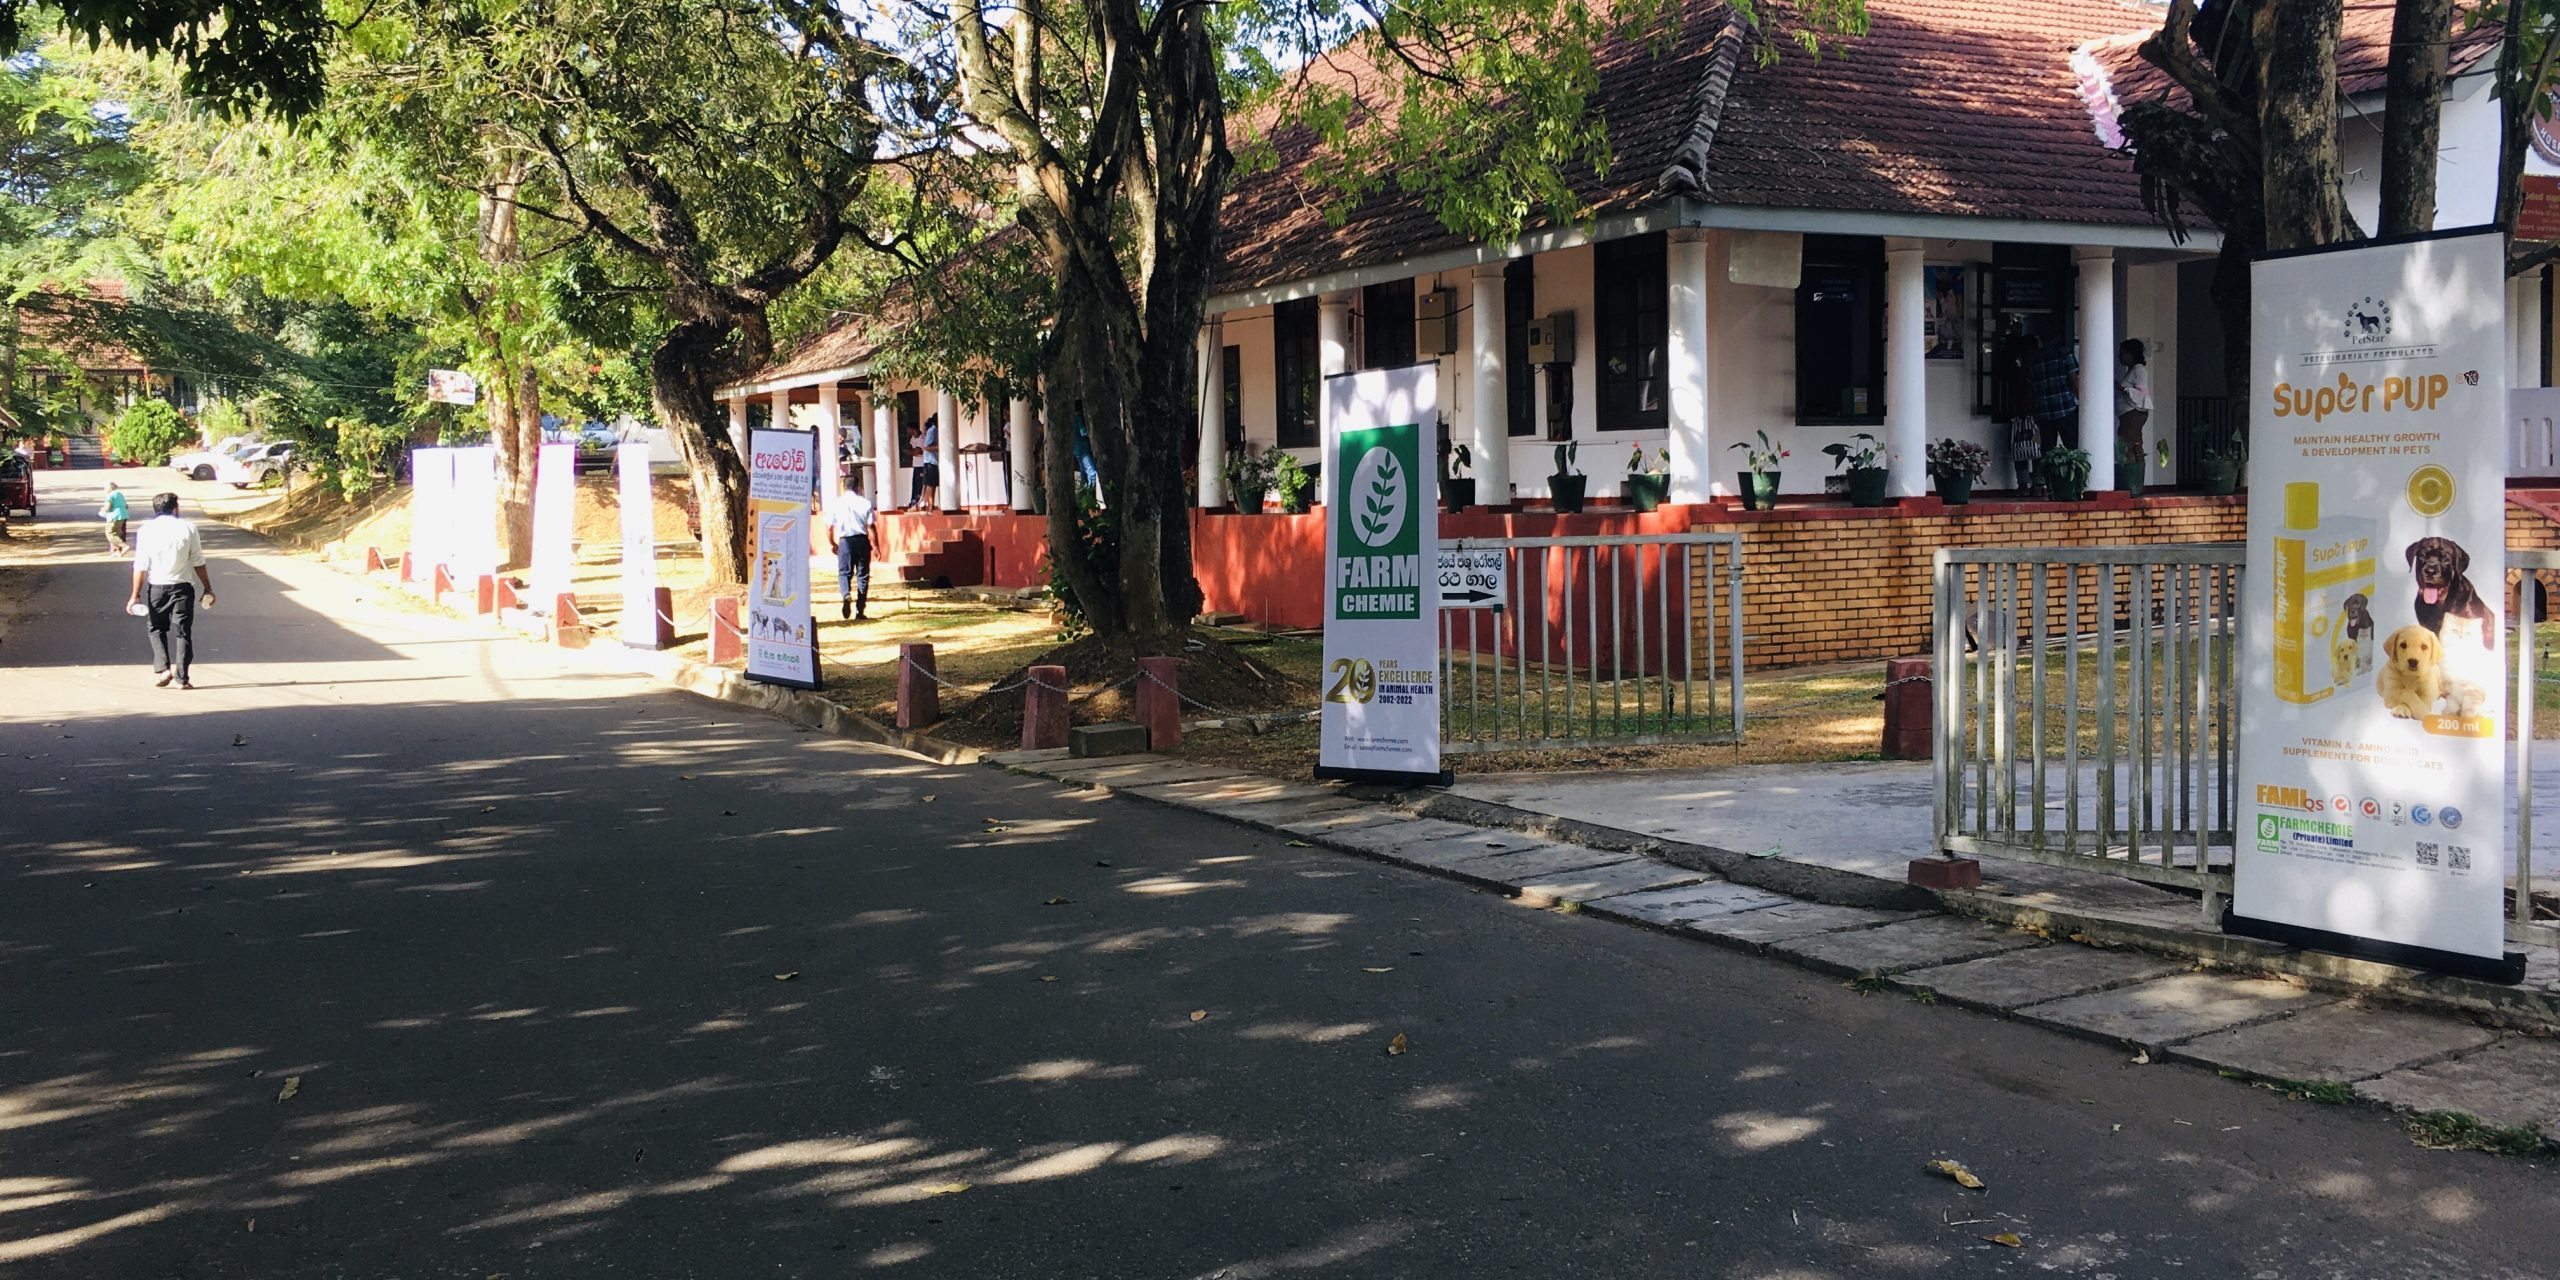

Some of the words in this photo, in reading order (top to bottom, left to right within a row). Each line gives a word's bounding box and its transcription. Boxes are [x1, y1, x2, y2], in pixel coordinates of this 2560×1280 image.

[2352, 335, 2385, 344] PetStar
[2273, 372, 2375, 423] Super
[2384, 374, 2448, 411] PUP
[2293, 435, 2341, 446] MAINTAIN
[2344, 433, 2390, 444] HEALTHY
[2394, 432, 2440, 443] GROWTH
[2302, 448, 2309, 457] &
[2311, 446, 2387, 457] DEVELOPMENT
[2389, 446, 2400, 455] IN
[2403, 444, 2431, 455] PETS
[1338, 554, 1419, 589] FARM
[1439, 572, 1461, 587] රථ
[1466, 575, 1498, 589] ගාල
[1343, 594, 1415, 612] CHEMIE
[1379, 660, 1398, 669] YEARS
[1379, 670, 1433, 683] EXCELLENCE
[1379, 685, 1386, 693] IN
[1386, 685, 1409, 694] ANIMAL
[1410, 685, 1433, 694] HEALTH
[1379, 695, 1412, 704] 2002-2022
[2438, 718, 2459, 730] 200
[2463, 719, 2480, 732] ml
[2302, 737, 2342, 749] VITAMIN
[2345, 741, 2352, 749] &
[2358, 743, 2391, 753] AMINO
[2283, 747, 2348, 760] SUPPLEMENT
[2351, 754, 2370, 763] FOR
[2373, 755, 2401, 767] DO
[2280, 817, 2353, 838] FARMCHEMIE
[2293, 832, 2326, 844] (Private)
[2326, 836, 2354, 848] Limited
